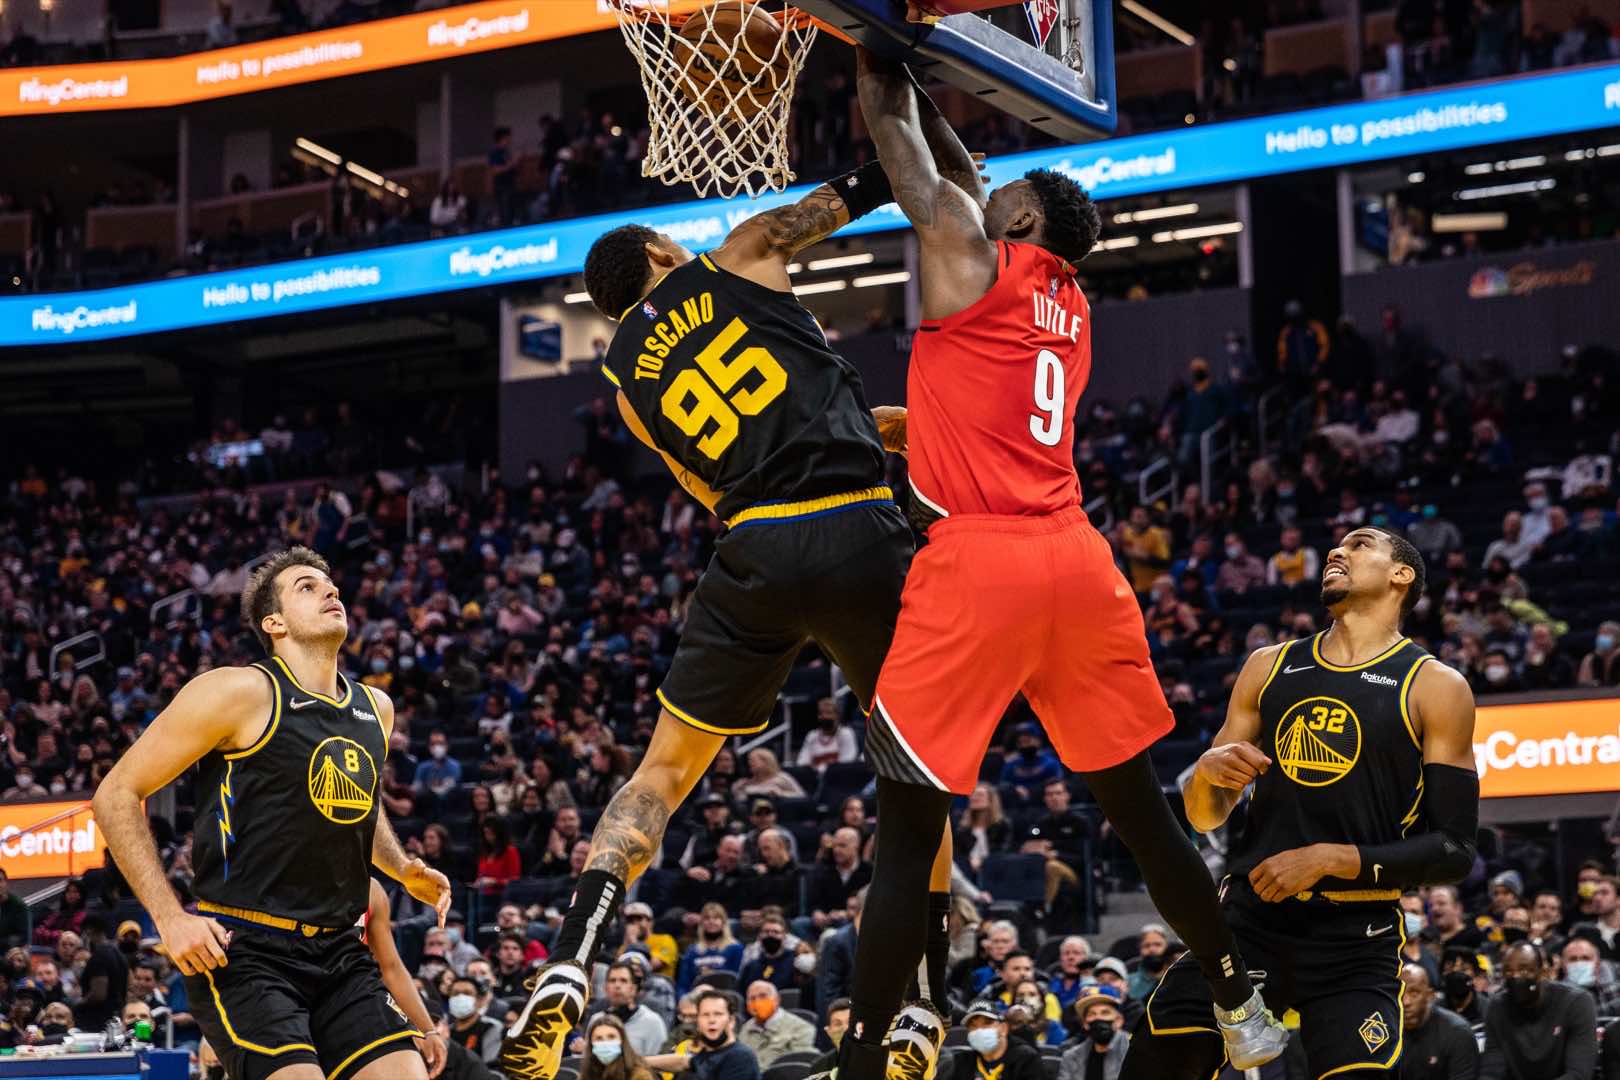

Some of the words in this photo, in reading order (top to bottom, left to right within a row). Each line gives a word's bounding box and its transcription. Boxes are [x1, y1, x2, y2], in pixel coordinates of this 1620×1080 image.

[427, 8, 529, 47] RingCentral
[196, 60, 240, 84] Hello
[241, 58, 261, 77] to
[262, 40, 363, 77] possibilities
[19, 74, 128, 105] RingCentral
[1265, 126, 1328, 154] Hello
[1331, 123, 1358, 145] to
[1361, 101, 1508, 146] possibilities
[1051, 146, 1176, 190] ingCentral
[450, 236, 557, 276] RingCentral
[203, 282, 249, 308] Hello
[250, 281, 271, 301] to
[272, 265, 381, 303] possibilities
[32, 299, 137, 334] RingCentral
[635, 292, 714, 381] TOSCANO
[1033, 288, 1083, 343] LITTLE
[660, 316, 788, 461] 95
[1029, 348, 1065, 446] 9
[1360, 671, 1398, 687] Rakuten
[1308, 705, 1348, 734] 32
[344, 748, 360, 773] 8
